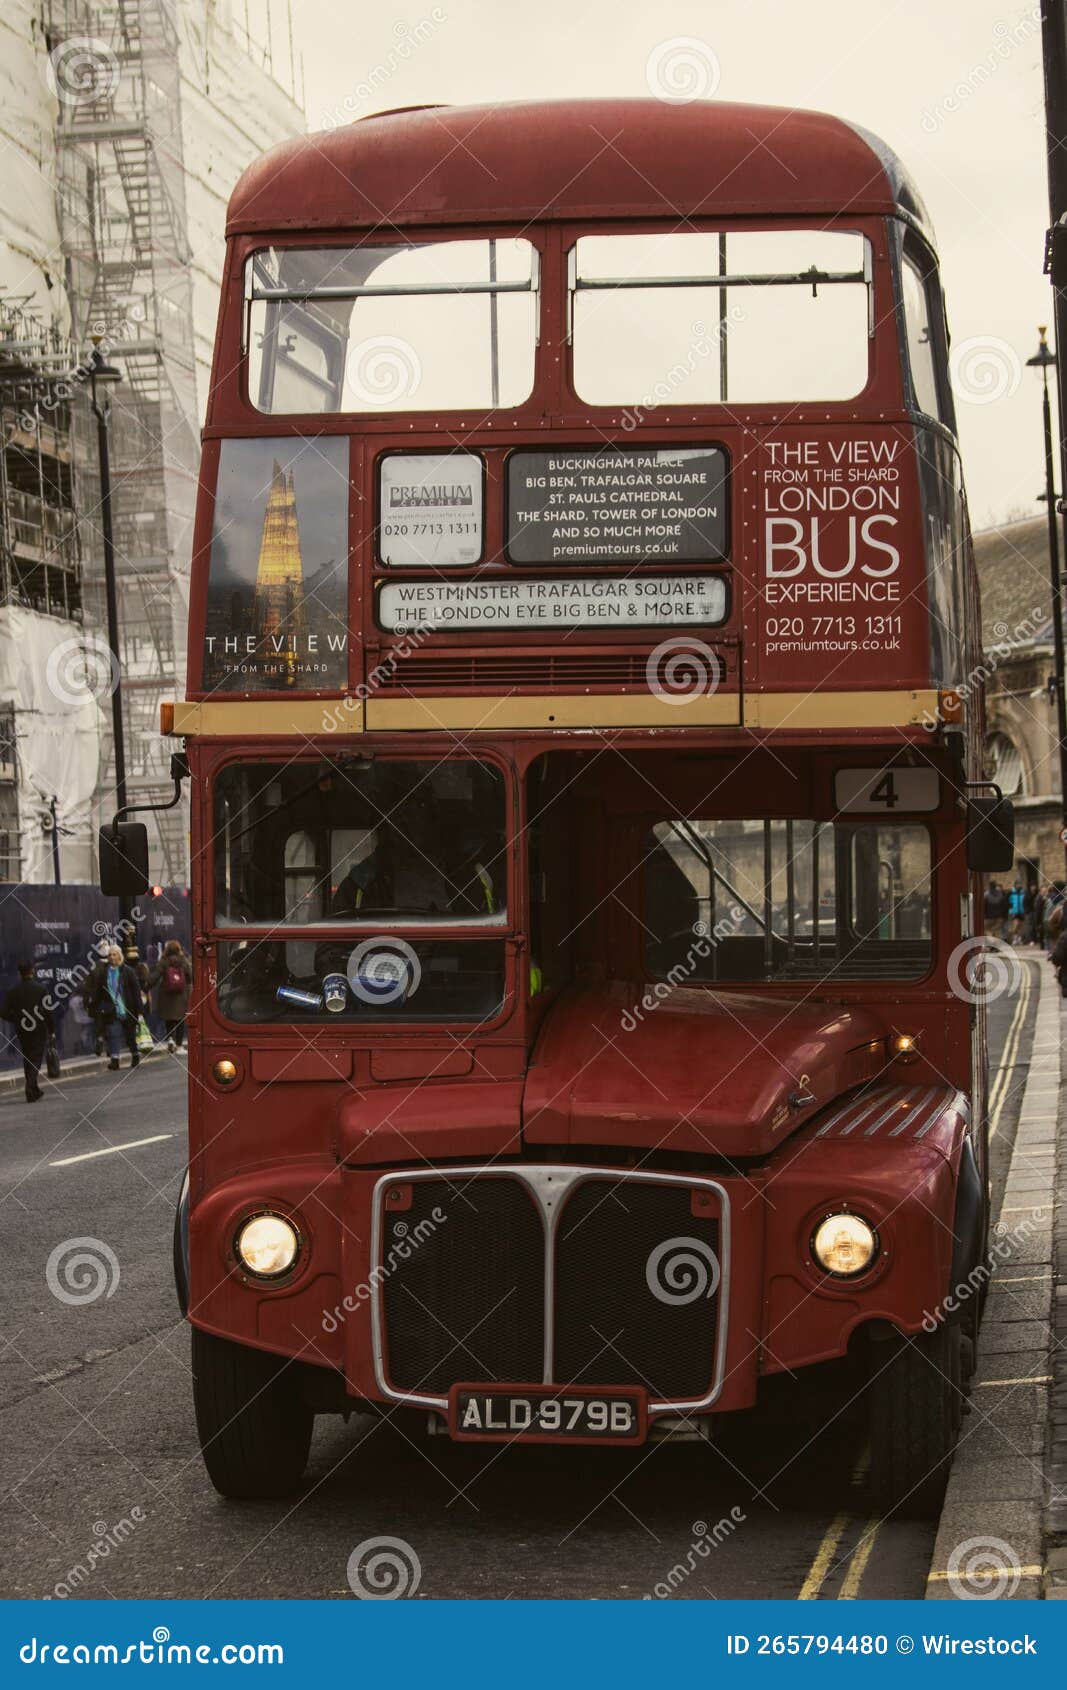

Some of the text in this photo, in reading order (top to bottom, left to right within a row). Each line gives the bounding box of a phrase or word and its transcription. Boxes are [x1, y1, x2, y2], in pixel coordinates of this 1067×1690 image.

[765, 440, 899, 464] THE VIEW
[549, 457, 684, 470] BUCKINGHAM PALACE
[526, 477, 546, 488] BIG
[581, 475, 652, 486] TRAFALGAR
[656, 473, 707, 485] SQUARE
[764, 467, 899, 483] FROM THE SHARD
[390, 485, 472, 500] PREMIUM
[549, 491, 684, 504] ST. PAULS CATHEDRAL
[765, 486, 900, 512] LONDON
[400, 499, 462, 507] COACHES
[517, 511, 540, 522] THE
[592, 509, 637, 520] TOWER
[641, 508, 657, 519] OF
[661, 507, 717, 519] LONDON
[385, 523, 477, 536] 020 7713 1311
[552, 525, 681, 538] AND SO MUCH MORE
[553, 542, 679, 557] premiumtours.co.uk
[766, 514, 900, 578] BUS
[399, 582, 706, 601] WESTMINSTER TRAFALGAR SQUARE
[765, 582, 900, 603] EXPERIENCE
[394, 607, 427, 622] THE
[433, 605, 510, 620] LONDON
[516, 604, 547, 618] EYE
[553, 603, 581, 617] BIG
[587, 603, 620, 617] BEN
[627, 603, 638, 616] &
[766, 616, 901, 636] 020 7713 1311
[205, 634, 347, 654] THE VIEW
[765, 637, 900, 656] premiumtours.co.uk
[226, 664, 328, 673] FROM THE SHARD
[869, 772, 899, 808] 4
